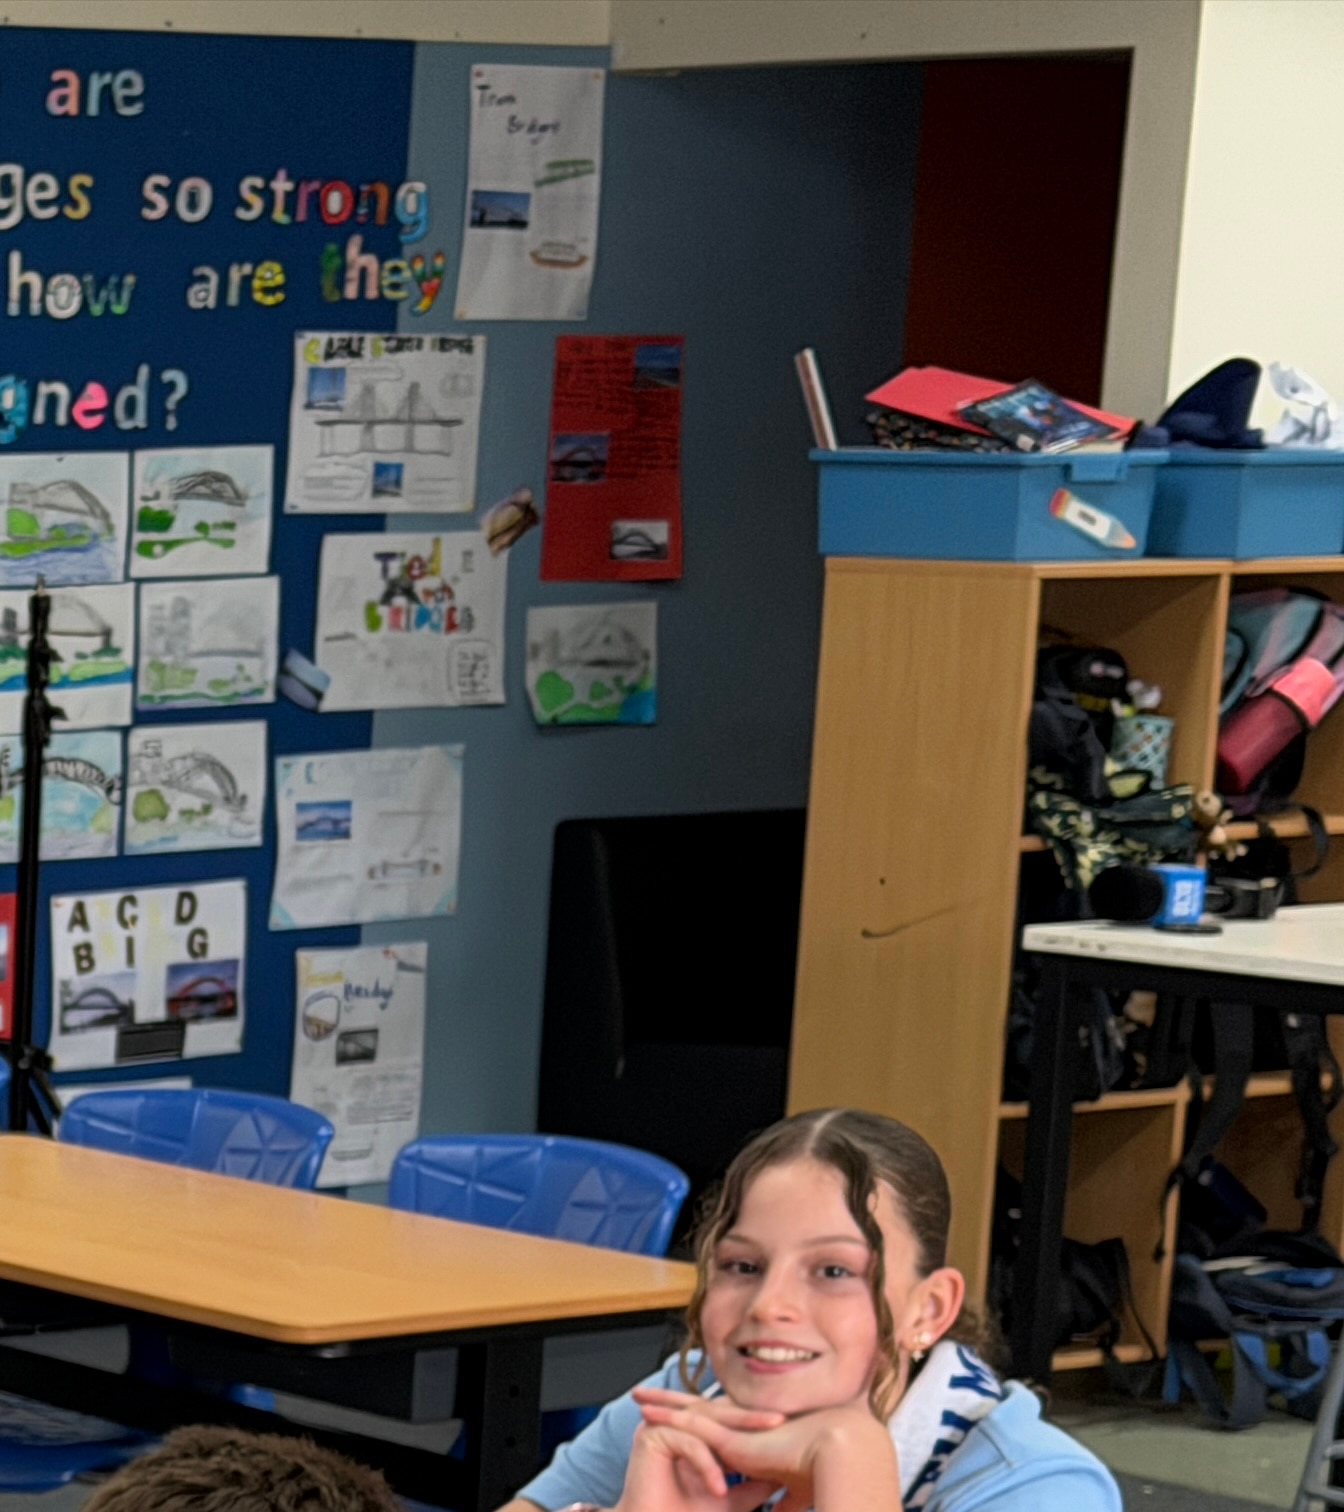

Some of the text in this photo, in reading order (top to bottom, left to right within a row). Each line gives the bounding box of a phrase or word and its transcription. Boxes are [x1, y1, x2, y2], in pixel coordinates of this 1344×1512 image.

[46, 69, 144, 117] are
[141, 173, 213, 223] so
[235, 168, 429, 243] strong
[7, 249, 137, 319] how
[186, 260, 286, 310] are
[320, 234, 446, 316] they
